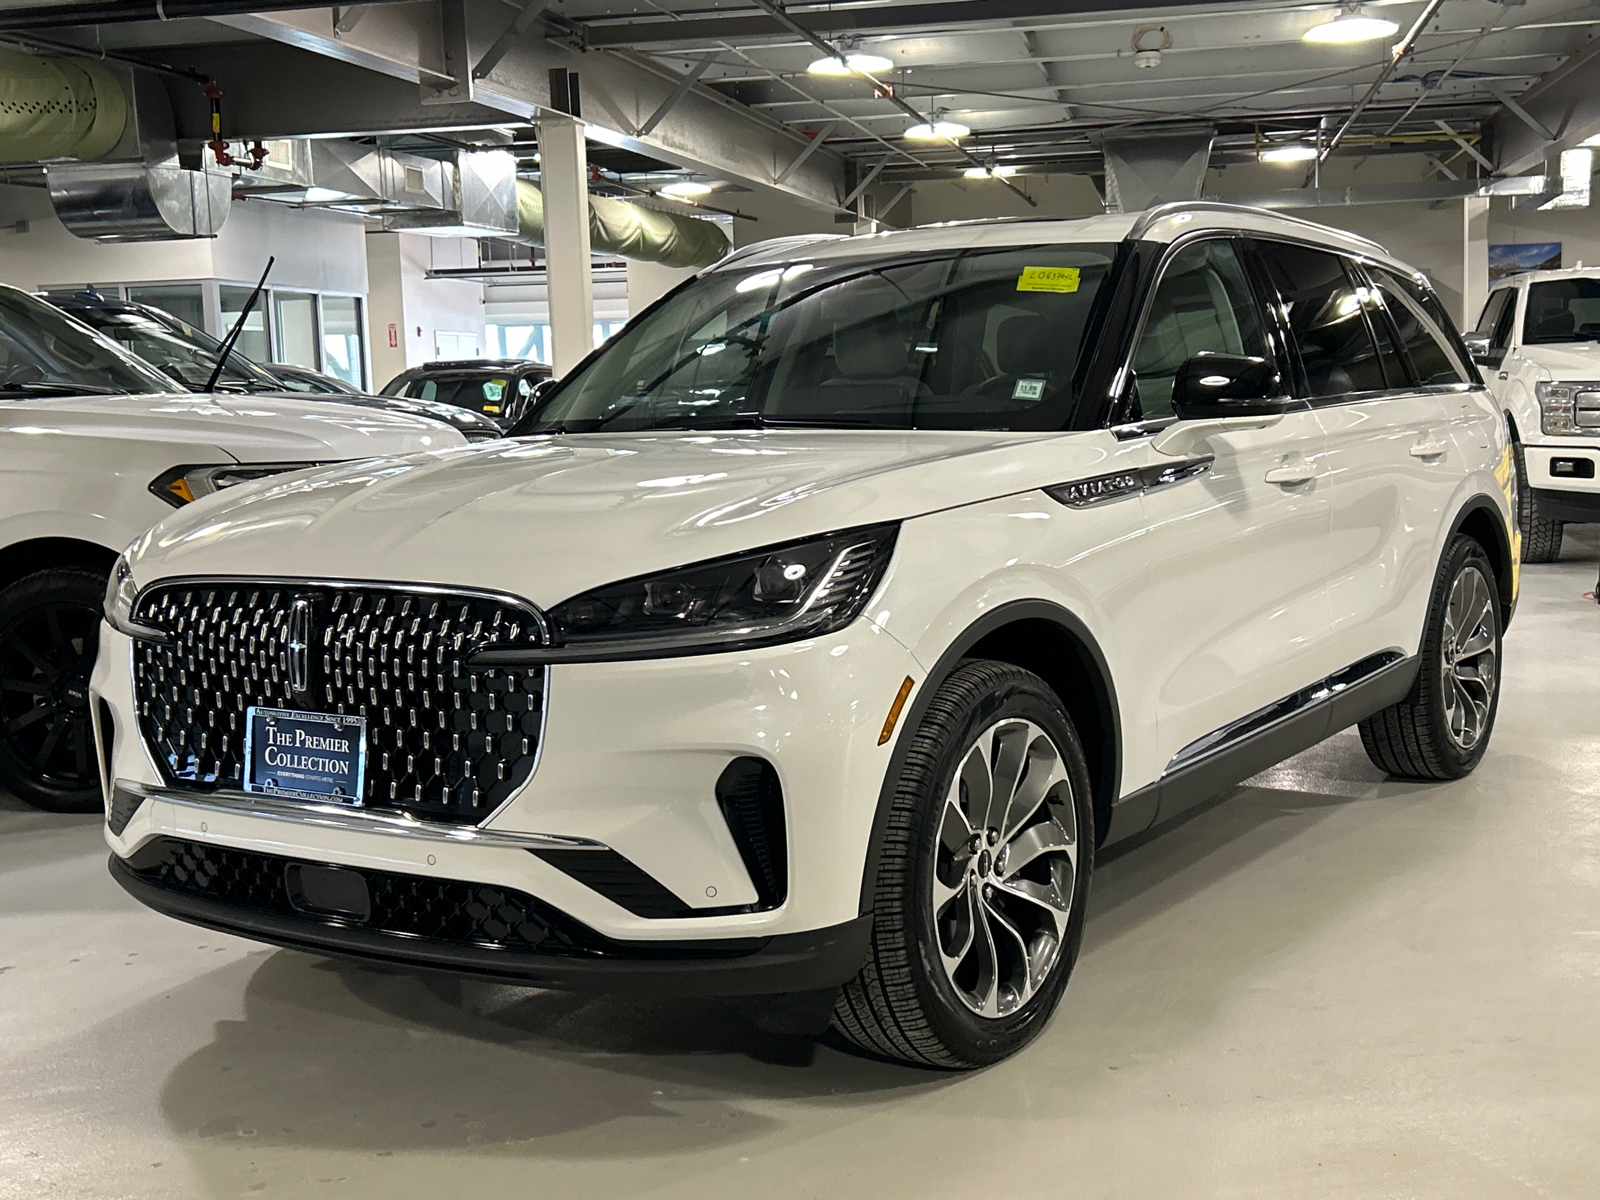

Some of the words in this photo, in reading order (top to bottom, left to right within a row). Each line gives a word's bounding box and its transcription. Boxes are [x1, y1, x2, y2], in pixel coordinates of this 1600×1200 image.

[1069, 476, 1134, 499] AVIATOR
[291, 711, 324, 721] EXCELLENCE
[325, 714, 341, 723] SINCE
[265, 726, 293, 747] THE
[295, 729, 350, 753] PREMIER
[264, 746, 350, 775] COLLECTION
